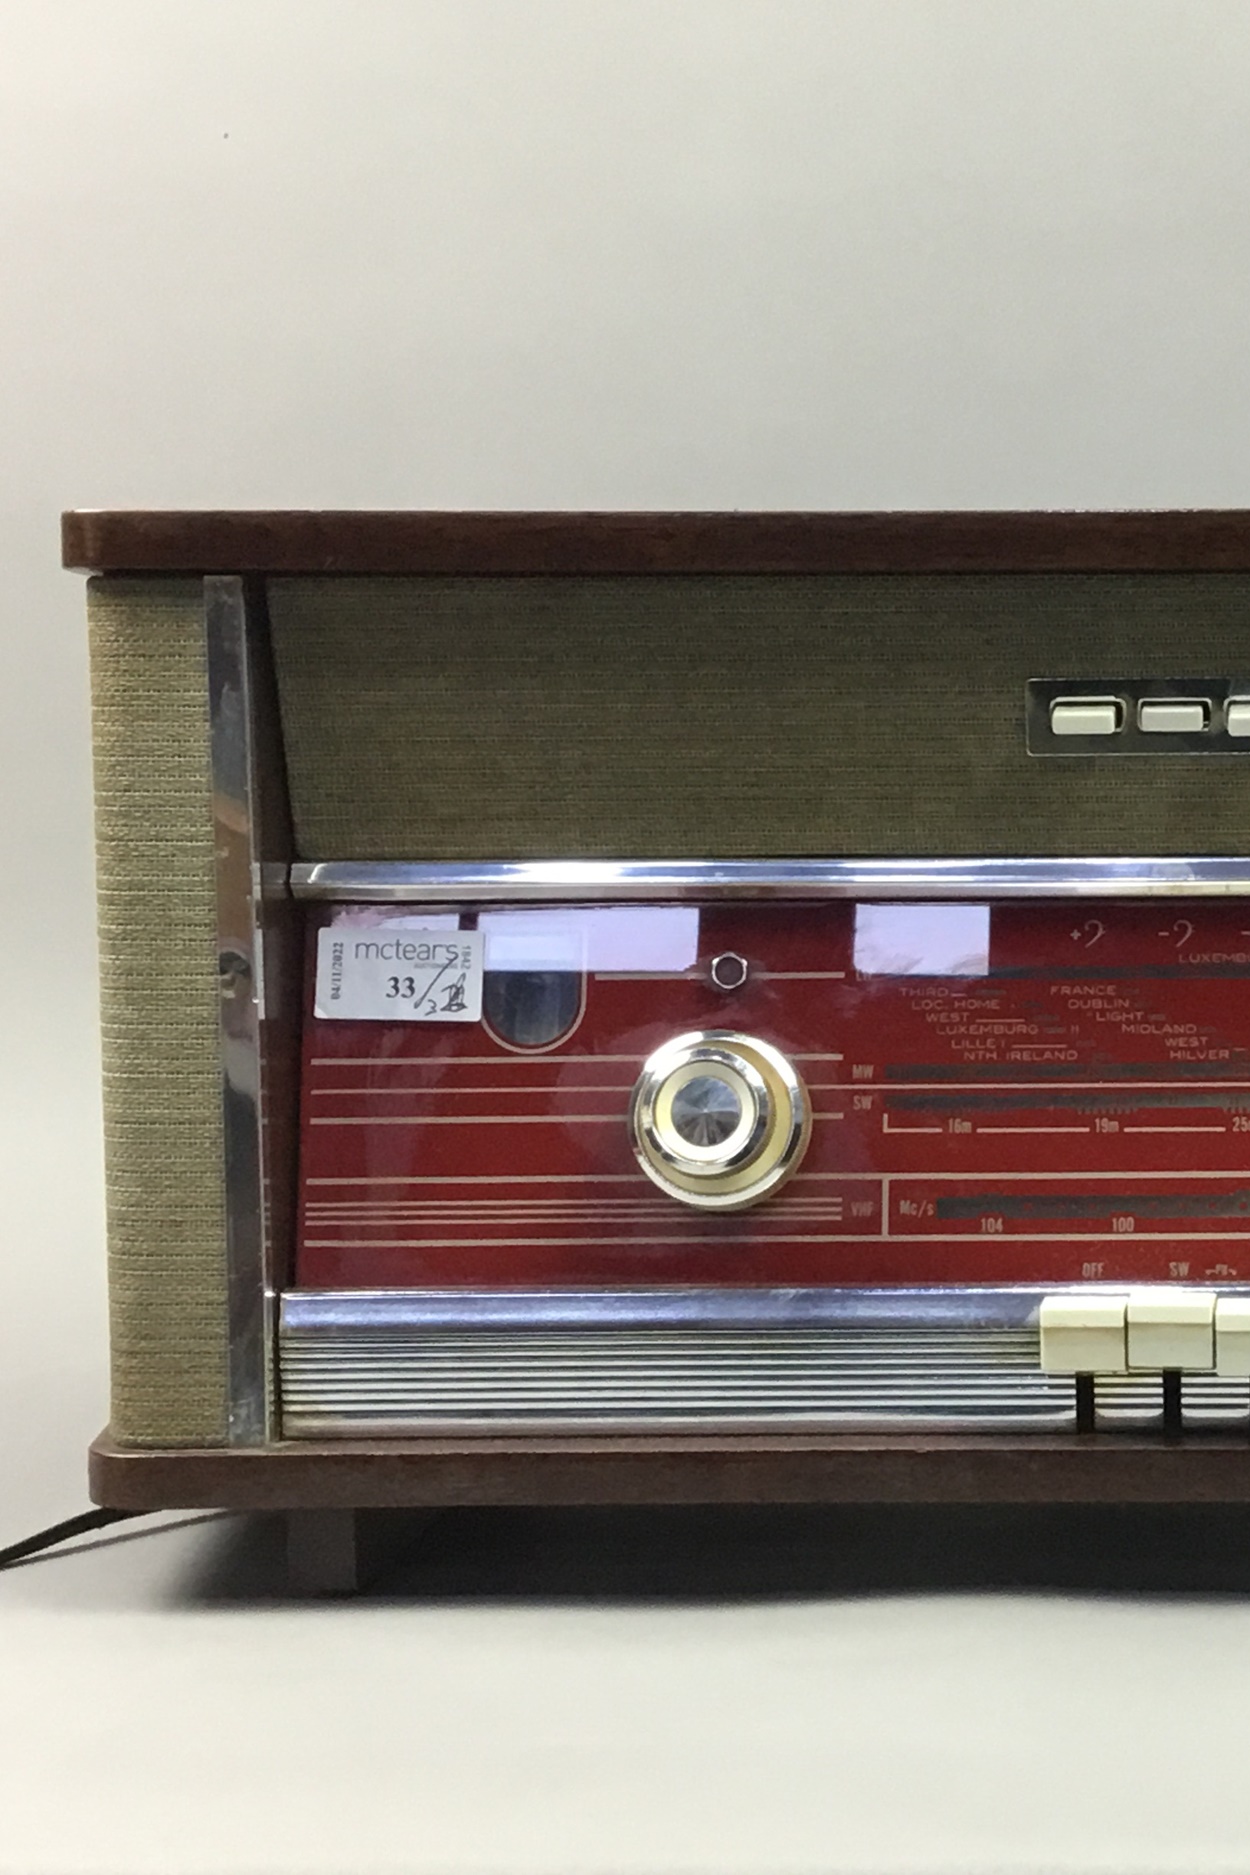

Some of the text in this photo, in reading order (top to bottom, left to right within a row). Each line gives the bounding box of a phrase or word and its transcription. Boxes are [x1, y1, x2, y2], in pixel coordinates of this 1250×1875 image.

[354, 939, 458, 961] mctears
[461, 945, 471, 969] 1842
[330, 942, 344, 1001] 04/11/2022
[385, 976, 416, 999] 33
[900, 988, 949, 997] THIRD
[1050, 985, 1116, 995] FRANCE
[954, 1000, 1000, 1010] HOME
[1068, 998, 1130, 1009] DUBLIN
[925, 1012, 971, 1022] WEST
[1095, 1011, 1144, 1022] LIGHT
[936, 1025, 1039, 1035] LUXEMBURG
[1121, 1023, 1197, 1034] MIDLAND
[951, 1039, 997, 1049] LILLE
[1164, 1036, 1209, 1047] WEST
[1006, 1050, 1079, 1061] IRELAND
[1169, 1050, 1230, 1060] HILVER
[852, 1064, 874, 1079] MW
[853, 1095, 873, 1110] SW
[948, 1118, 972, 1134] 16m
[1095, 1118, 1119, 1133] 19m
[852, 1202, 874, 1217] VHF
[900, 1200, 935, 1217] Mc/s
[980, 1218, 1003, 1233] 104
[1112, 1217, 1134, 1232] 100
[1082, 1262, 1104, 1278] OFF
[1169, 1262, 1189, 1277] SW
